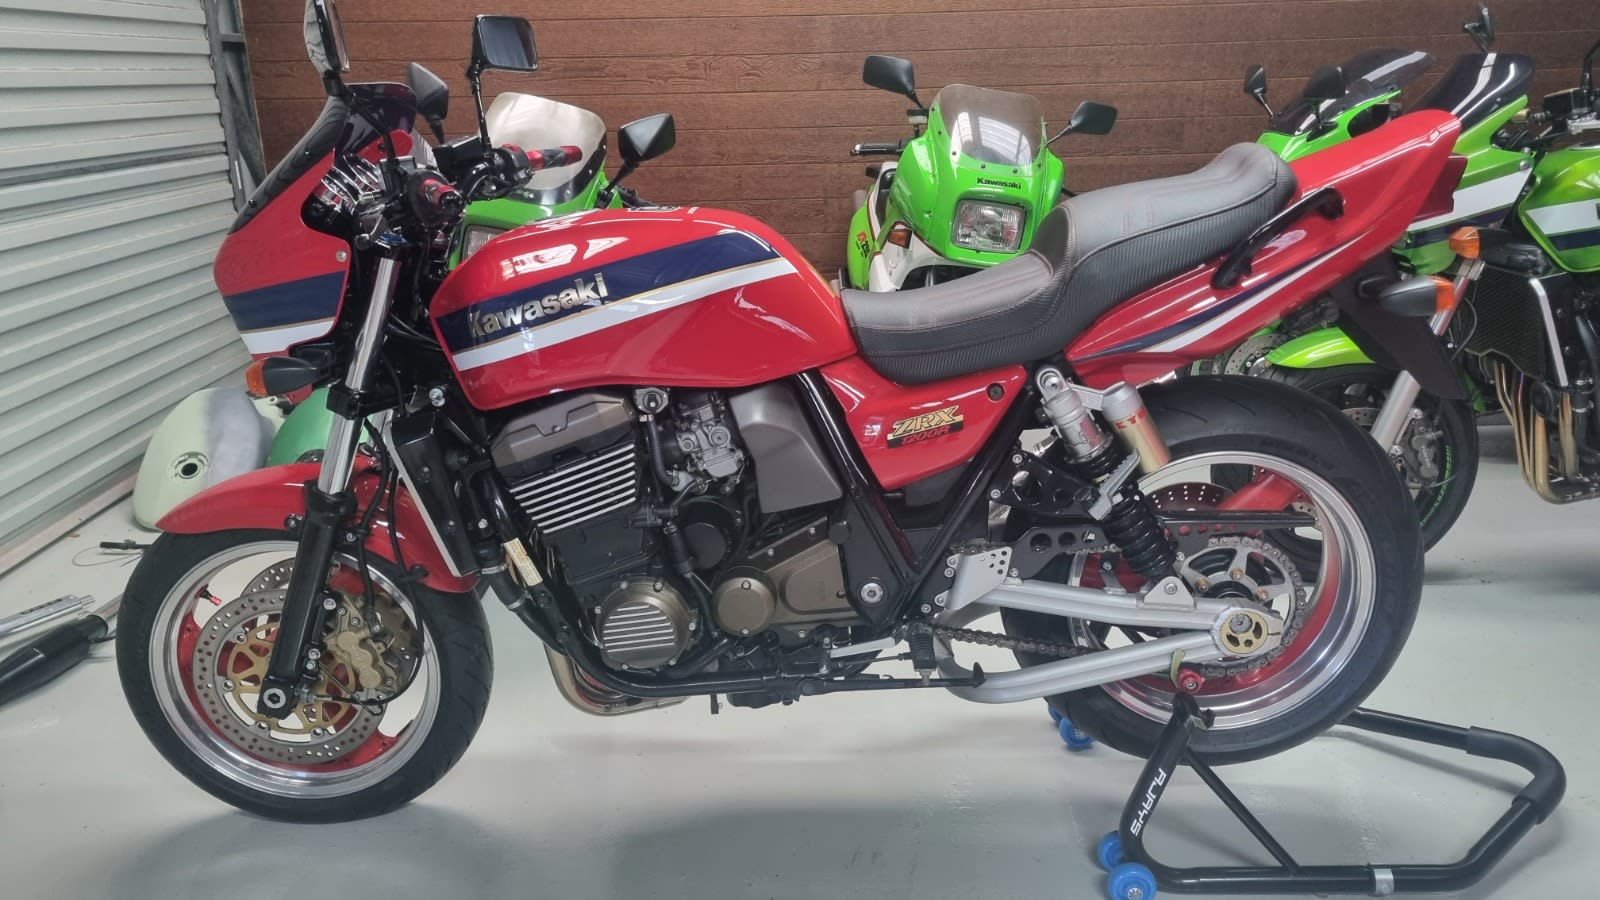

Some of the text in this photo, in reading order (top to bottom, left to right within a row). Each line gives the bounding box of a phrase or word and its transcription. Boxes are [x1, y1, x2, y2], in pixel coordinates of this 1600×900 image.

[977, 177, 1022, 190] Kawasaki
[468, 272, 608, 338] Kawasaki
[892, 405, 960, 437] ZRX
[1129, 767, 1167, 837] AJAYS
